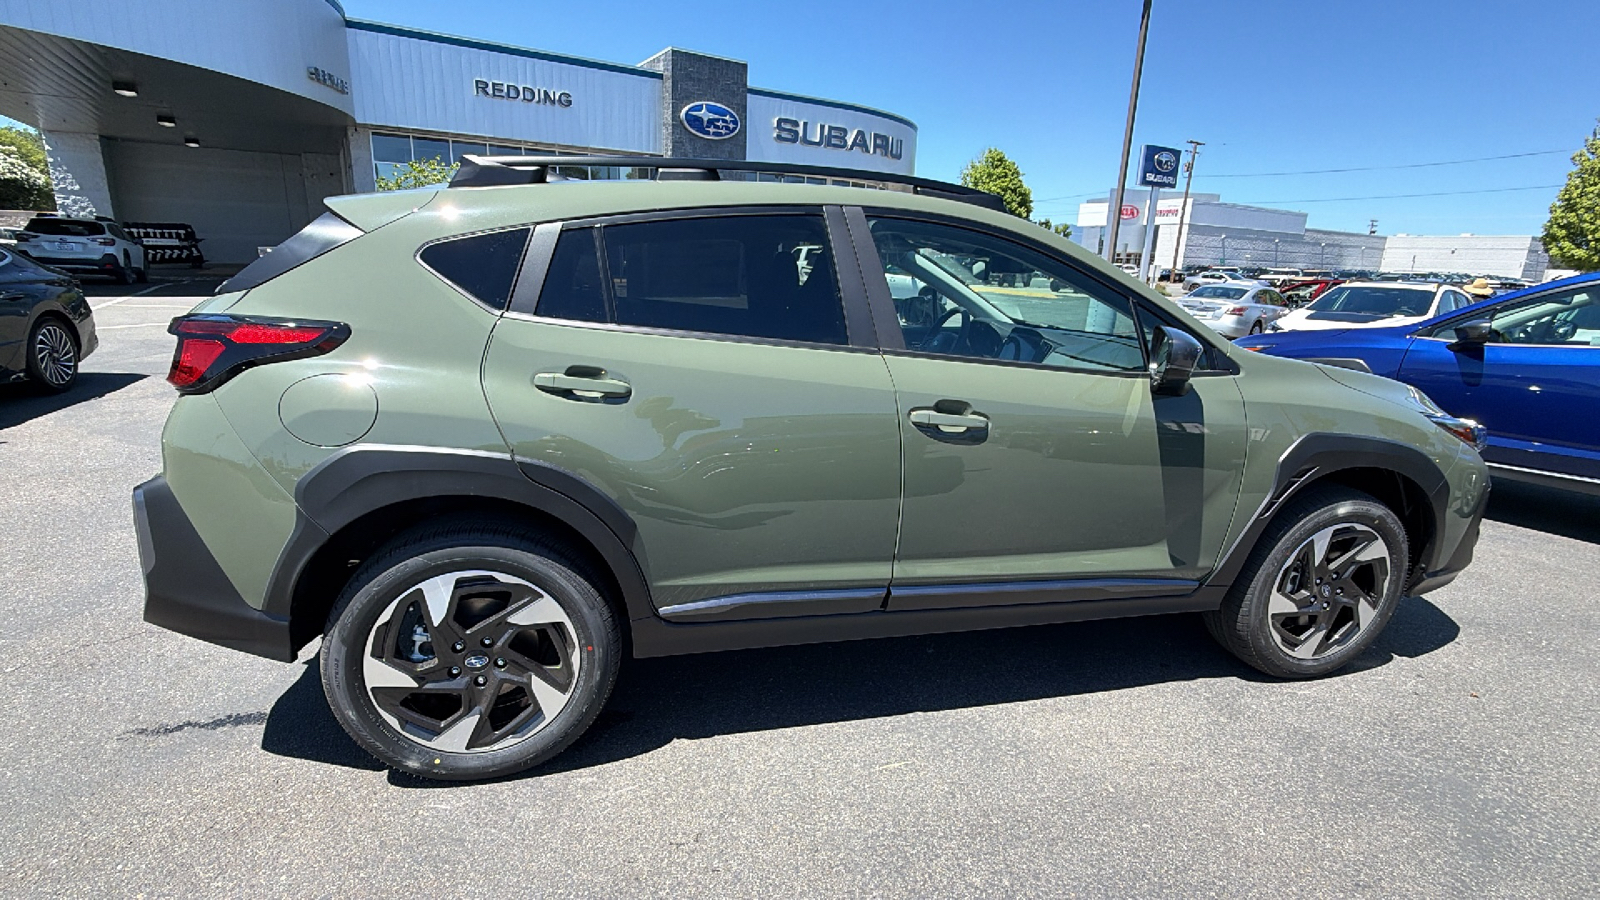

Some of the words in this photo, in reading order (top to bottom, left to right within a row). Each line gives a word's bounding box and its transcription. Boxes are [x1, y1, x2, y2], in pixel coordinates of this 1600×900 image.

[475, 79, 573, 107] REDDING
[774, 117, 902, 160] SUBARU
[1146, 173, 1176, 184] SUBARU
